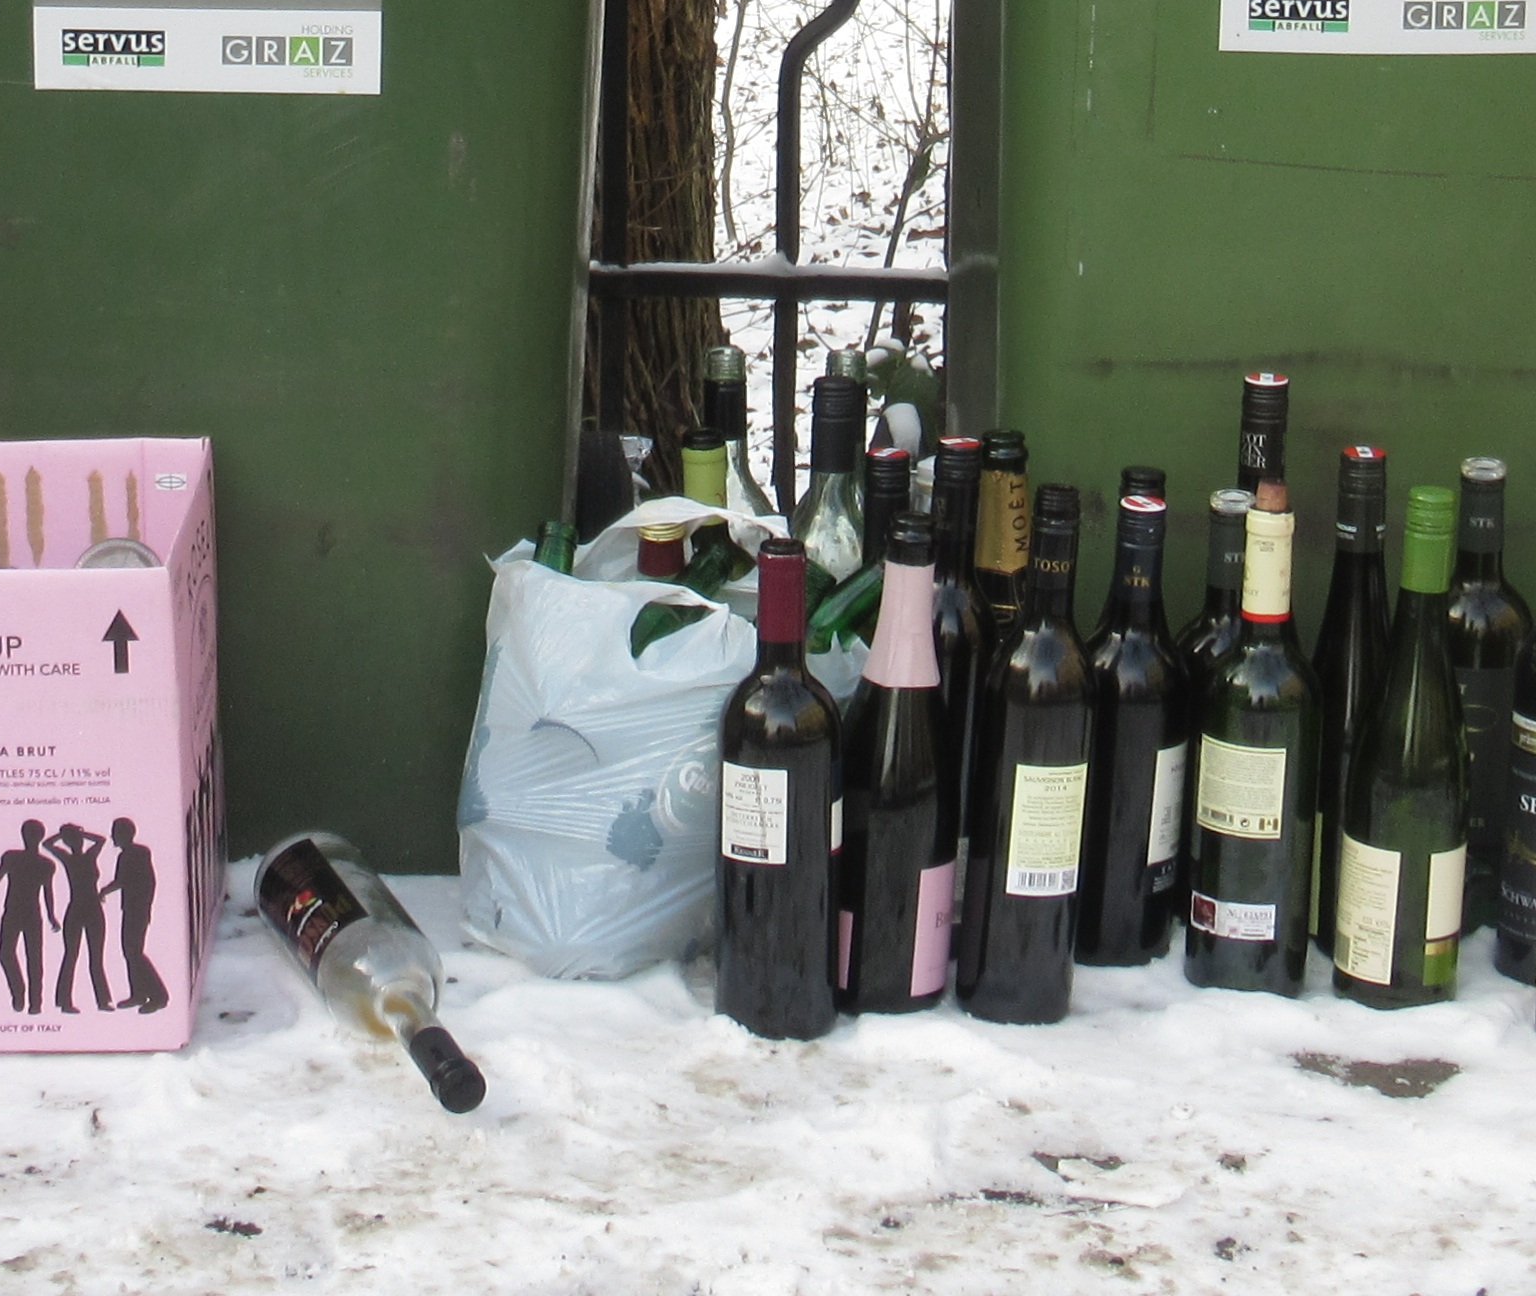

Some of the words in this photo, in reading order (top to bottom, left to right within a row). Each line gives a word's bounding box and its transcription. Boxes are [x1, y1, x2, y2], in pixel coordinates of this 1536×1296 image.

[1403, 1, 1525, 30] GRAZ
[301, 25, 354, 36] HOLDING
[1276, 21, 1322, 32] ABFALL
[63, 31, 164, 53] servus
[223, 37, 353, 66] GRAZ
[91, 55, 137, 66] ABFALL
[303, 67, 354, 79] SERVICES
[1008, 481, 1030, 552] MOËT
[39, 663, 81, 676] CARE
[17, 745, 57, 757] BRUT
[28, 769, 41, 778] 75
[44, 769, 58, 778] CL
[70, 768, 91, 778] 11%
[95, 767, 111, 778] vol
[21, 1025, 35, 1033] OF
[37, 1024, 62, 1033] ITALY
